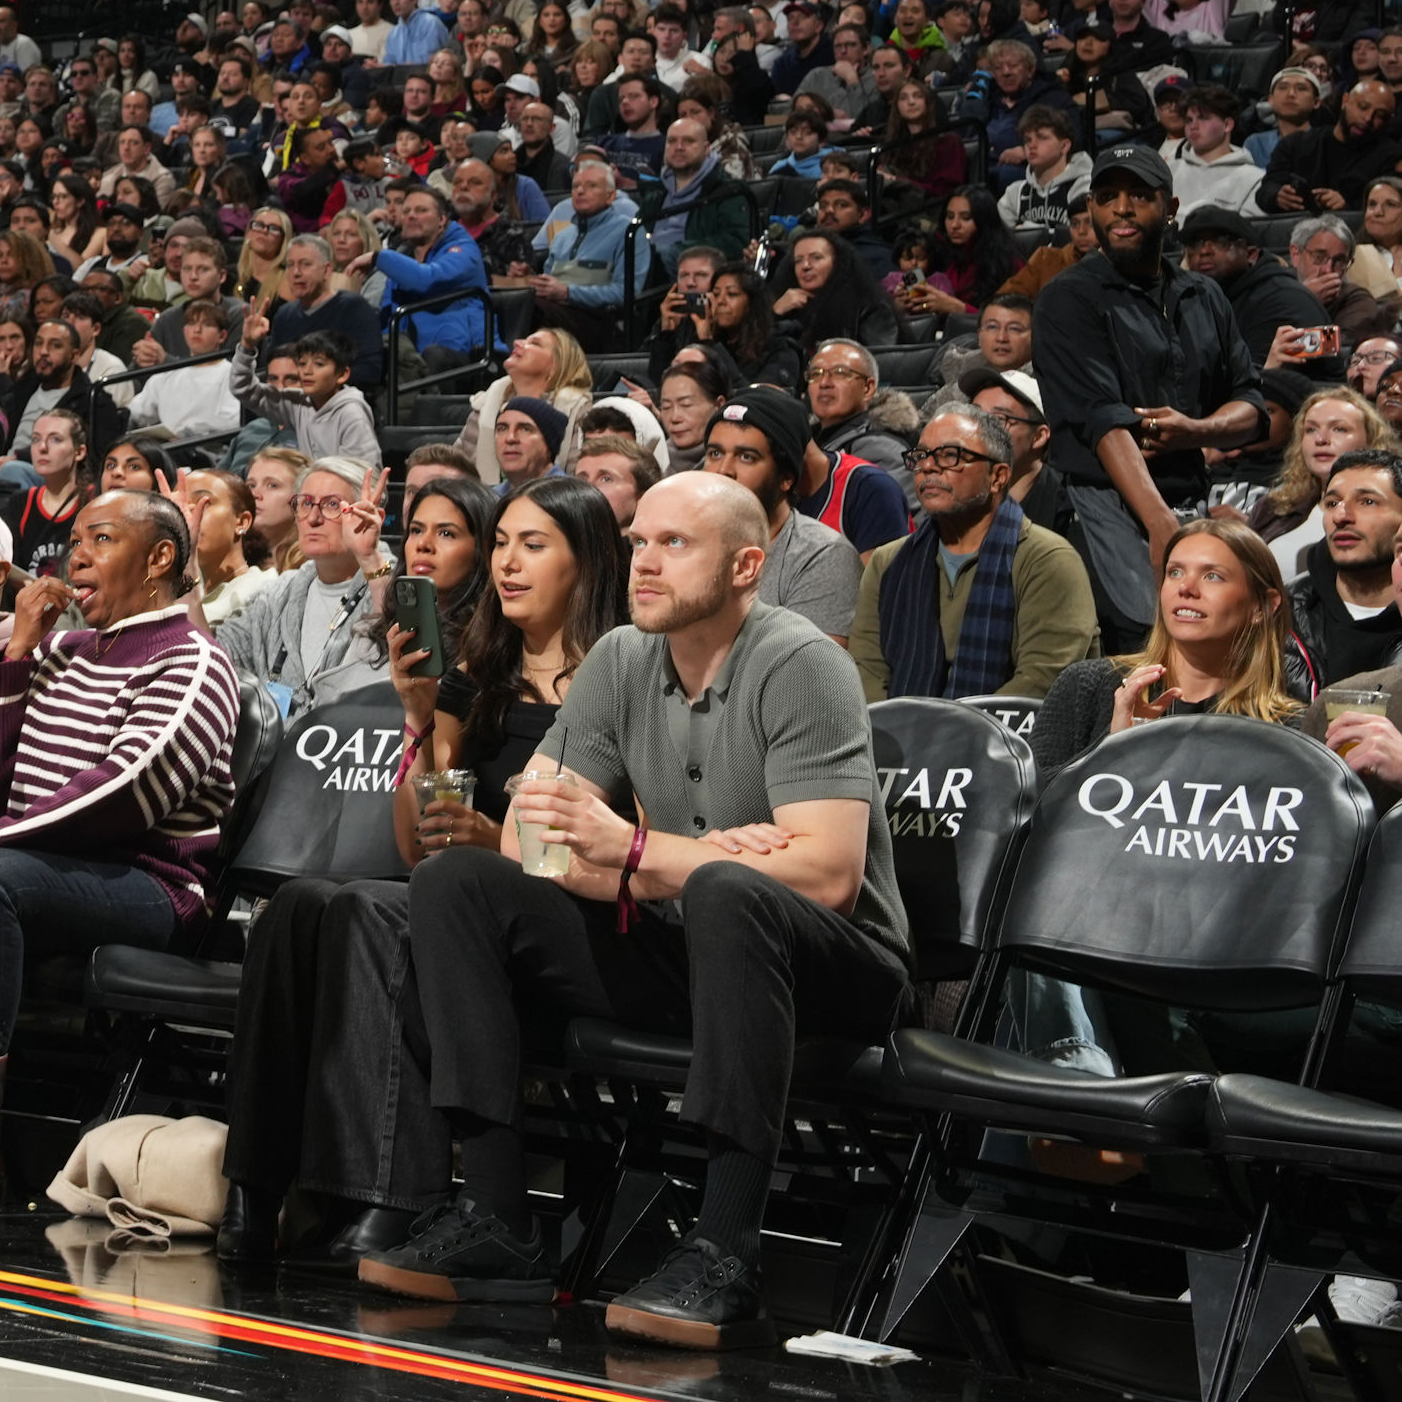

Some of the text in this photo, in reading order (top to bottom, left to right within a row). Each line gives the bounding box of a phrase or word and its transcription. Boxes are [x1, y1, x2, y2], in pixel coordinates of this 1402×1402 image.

[296, 724, 404, 771] QAT
[322, 766, 397, 793] AIRW
[875, 767, 1304, 832] TAR QATAR
[889, 811, 1297, 864] WAYS AIRWAYS
